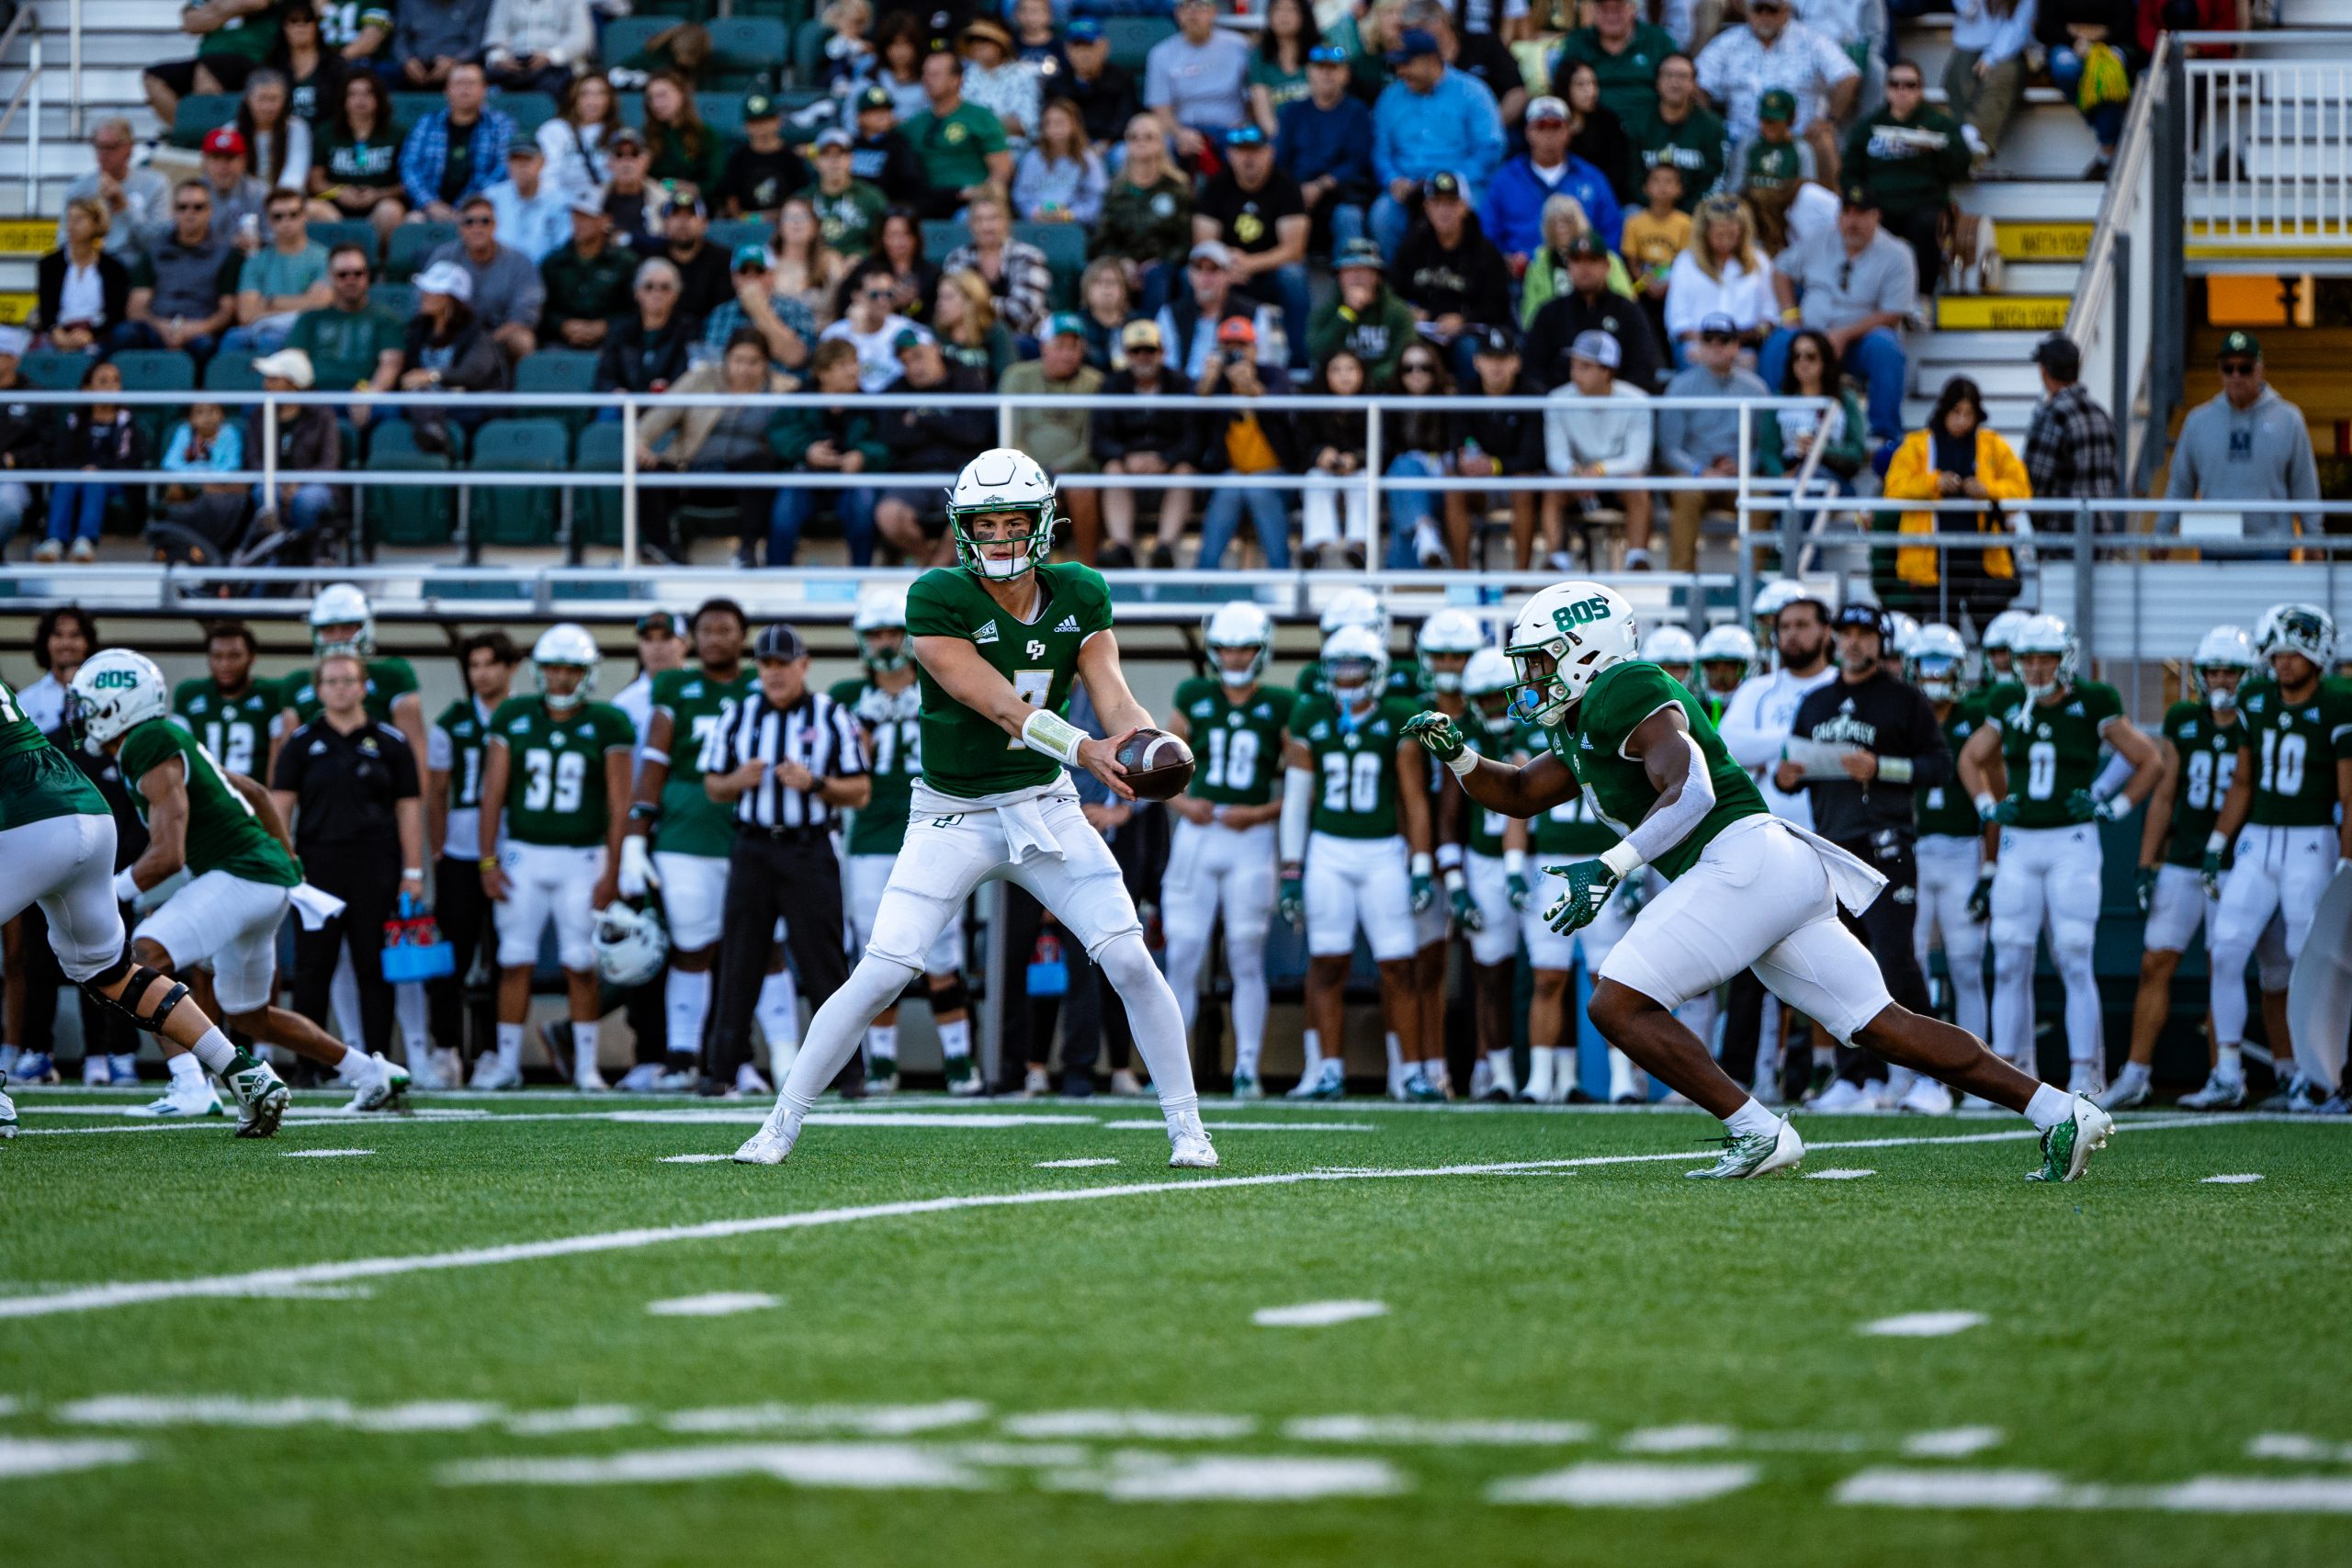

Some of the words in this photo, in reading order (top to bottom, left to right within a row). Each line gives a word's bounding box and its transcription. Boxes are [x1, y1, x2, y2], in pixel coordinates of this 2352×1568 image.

[1054, 625, 1080, 633] adidas
[1552, 597, 1611, 633] 805
[1026, 639, 1046, 660] CP
[95, 670, 138, 690] 805
[204, 720, 254, 775] 12
[2028, 740, 2056, 809] 0
[2259, 728, 2308, 796] 10
[524, 747, 586, 814] 39
[1322, 751, 1382, 813] 20
